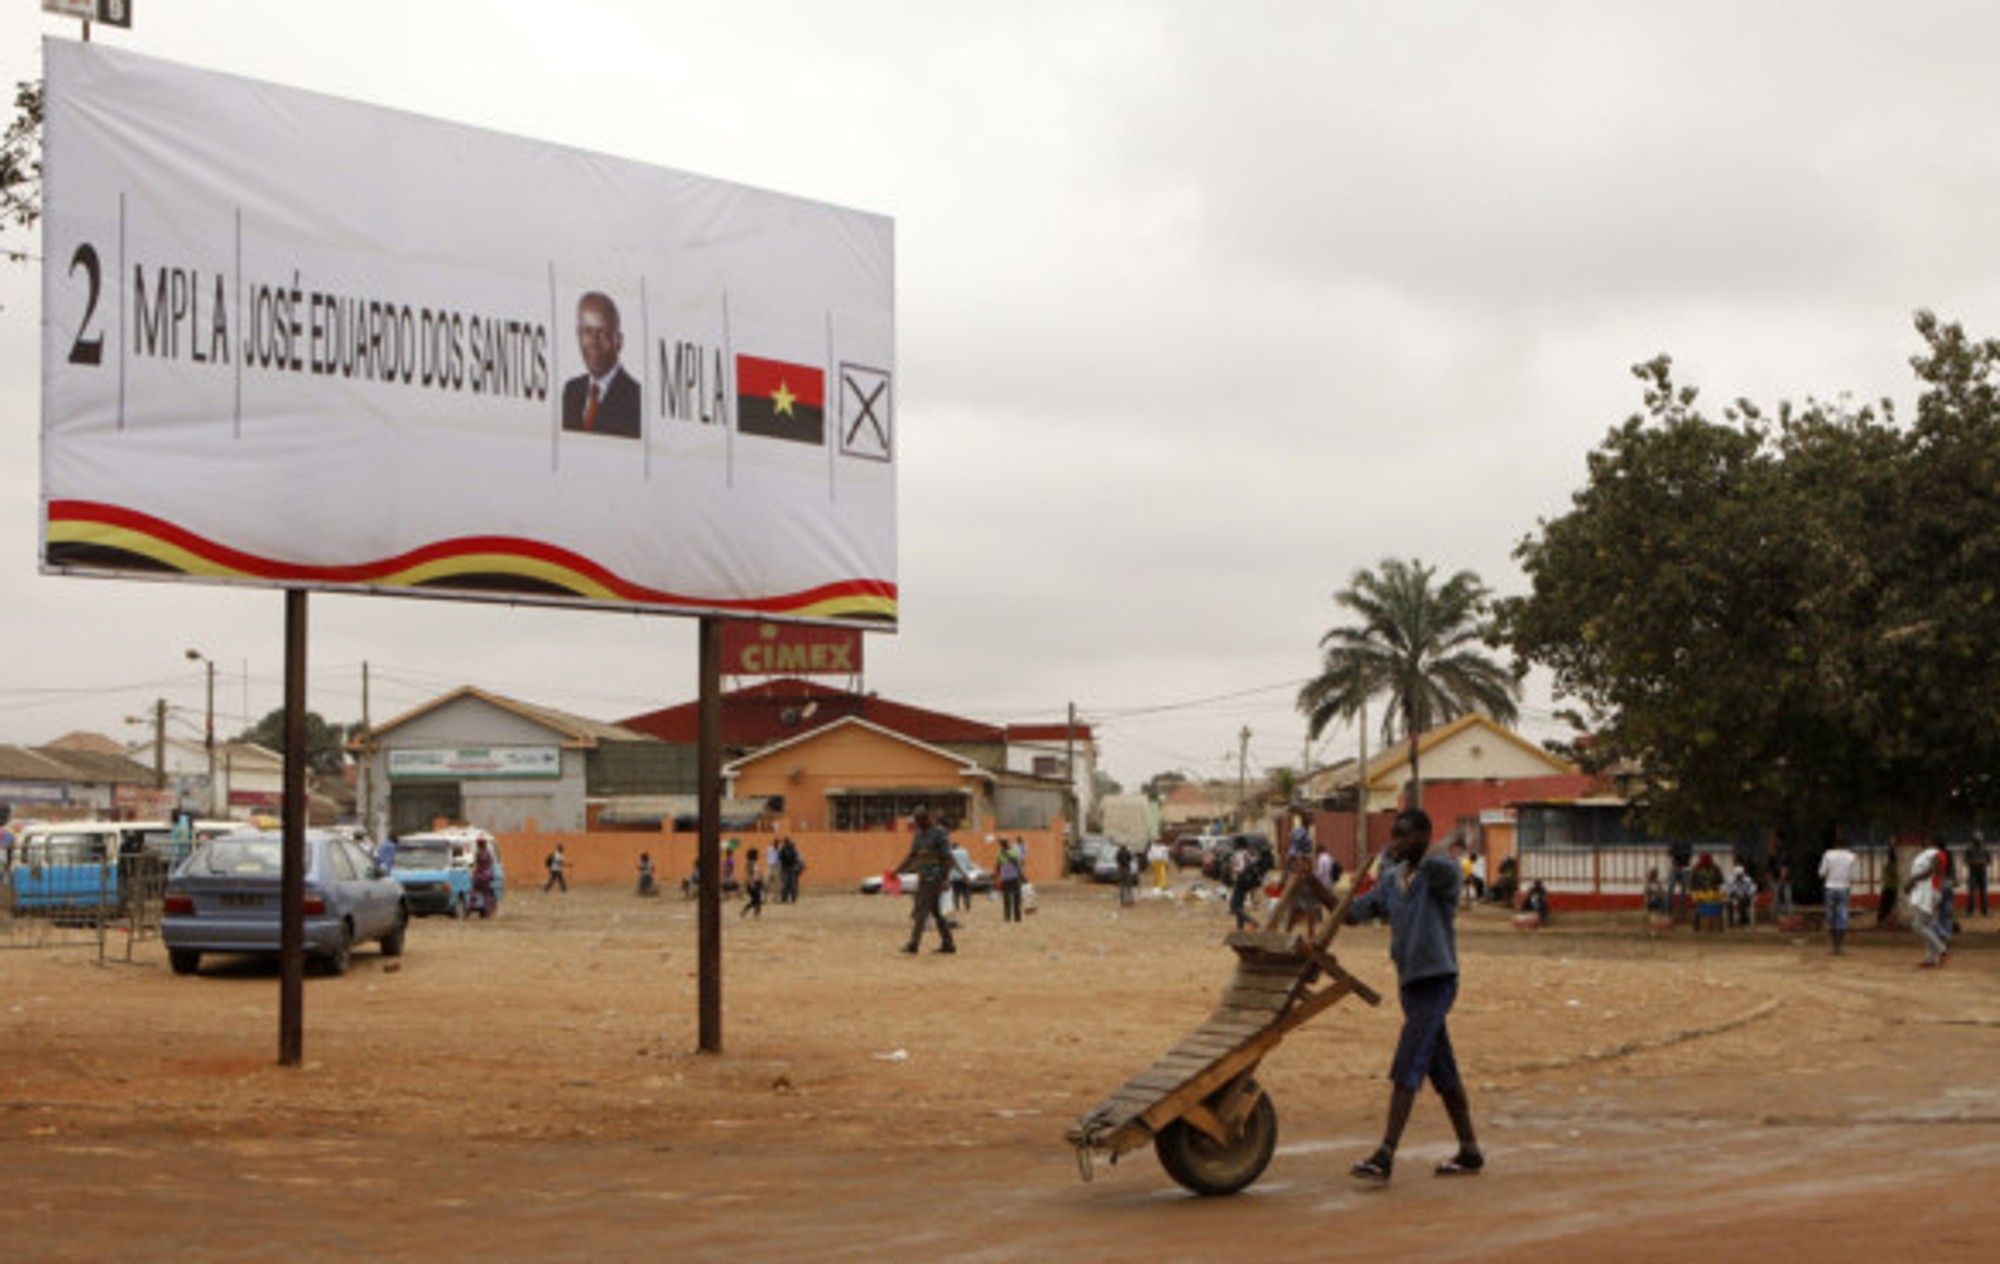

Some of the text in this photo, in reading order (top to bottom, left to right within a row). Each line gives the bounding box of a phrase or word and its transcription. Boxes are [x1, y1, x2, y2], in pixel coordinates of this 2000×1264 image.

[68, 243, 727, 425] 2 MPLA JOSÉ EDUARDO DOS SANTOS MPLA
[741, 639, 853, 671] CIMEX
